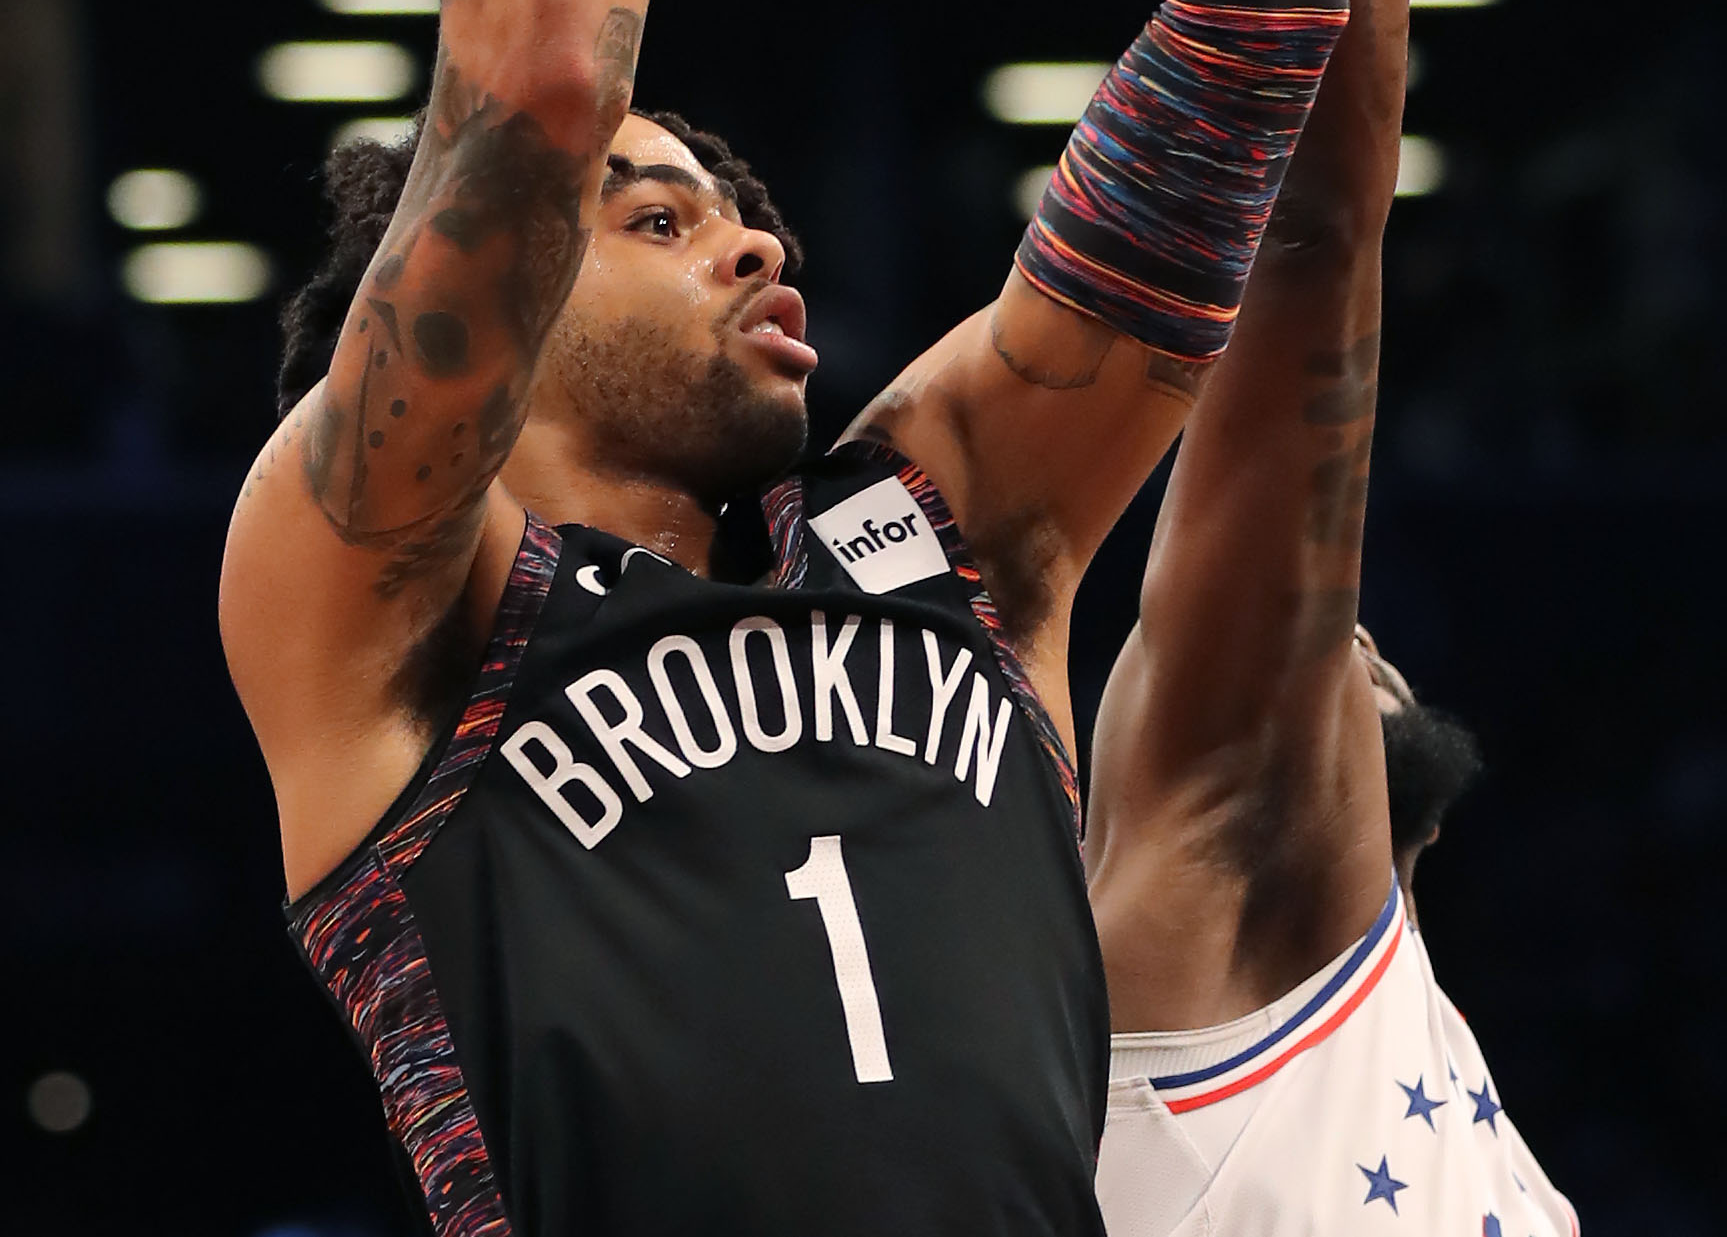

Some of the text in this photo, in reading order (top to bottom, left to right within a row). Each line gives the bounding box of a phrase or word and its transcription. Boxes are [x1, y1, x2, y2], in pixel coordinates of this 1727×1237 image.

[832, 512, 919, 563] infor
[499, 609, 1013, 850] BROOKLYN
[784, 834, 895, 1084] 1
